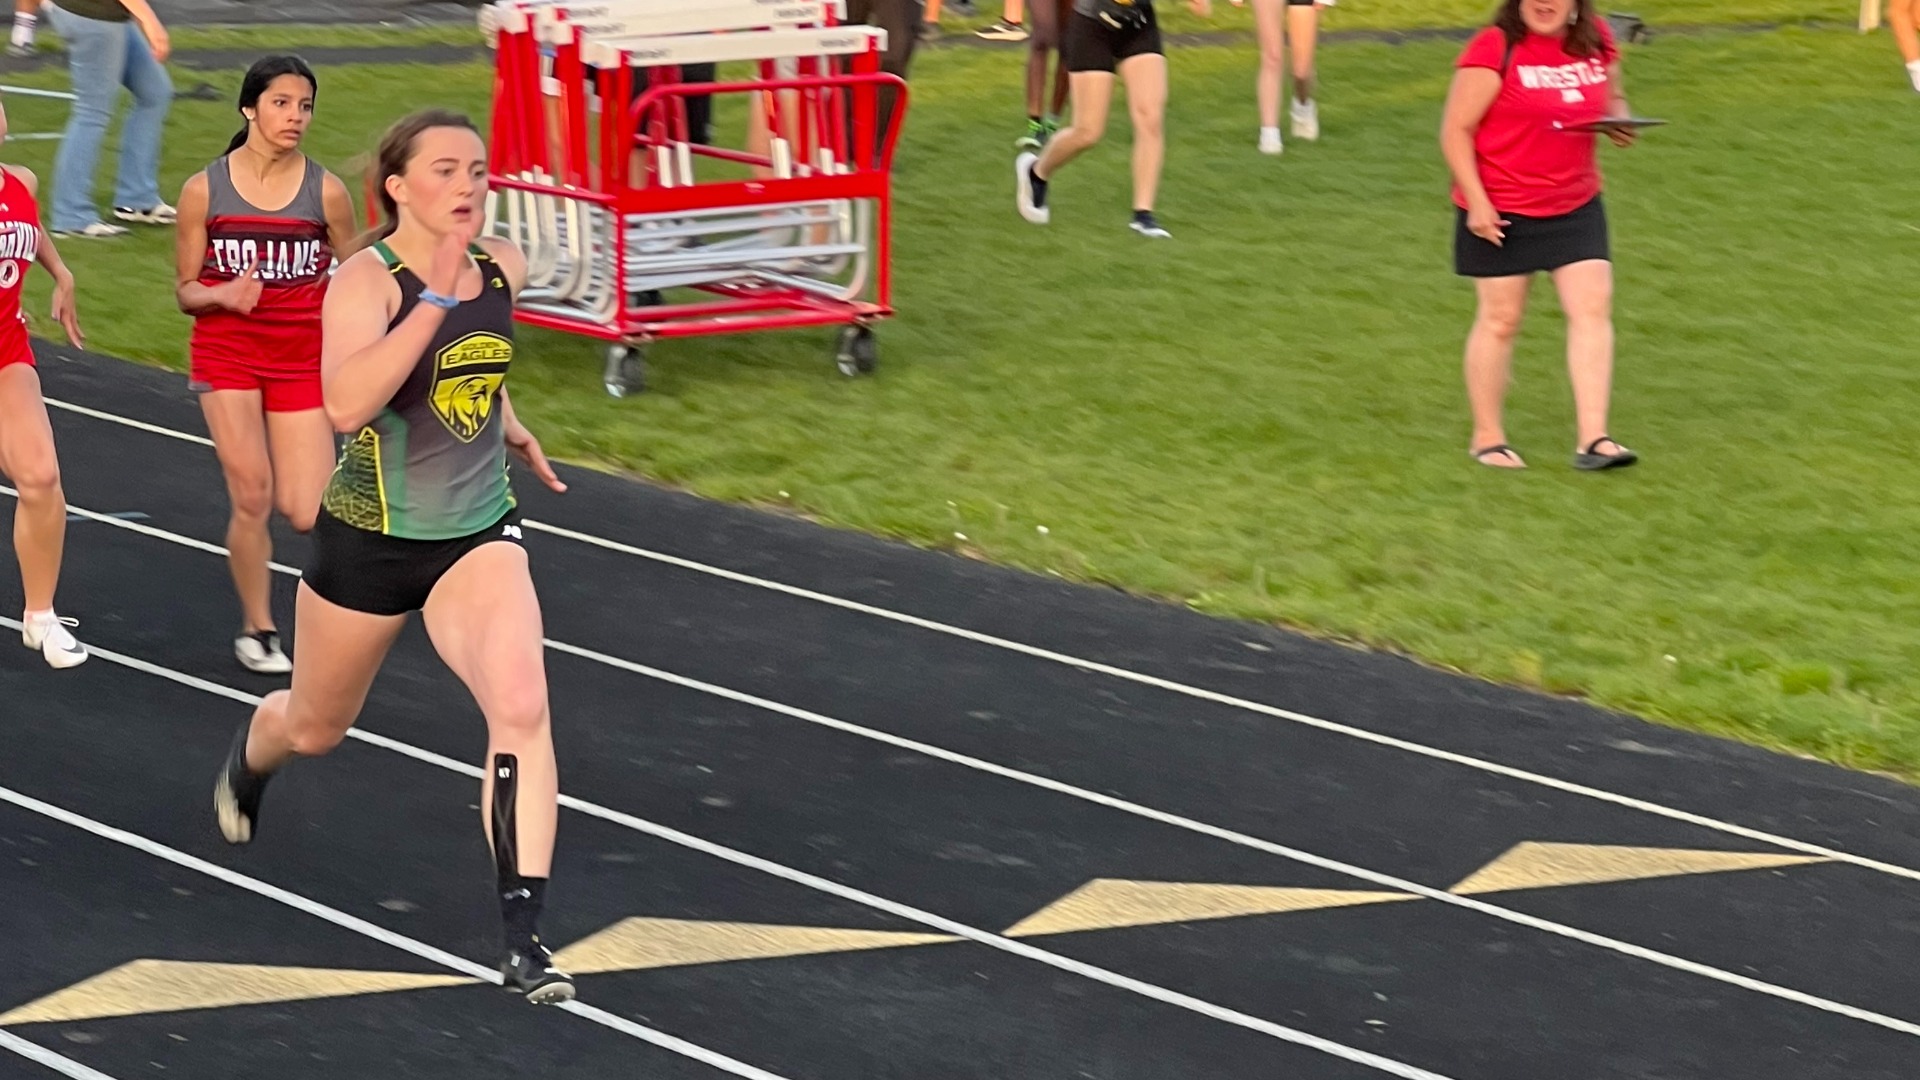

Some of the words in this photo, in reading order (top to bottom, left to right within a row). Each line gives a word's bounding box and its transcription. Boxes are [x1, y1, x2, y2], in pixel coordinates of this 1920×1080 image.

[212, 239, 320, 279] TROJANS
[460, 341, 500, 351] GOLDEN
[446, 348, 511, 365] EAGLES
